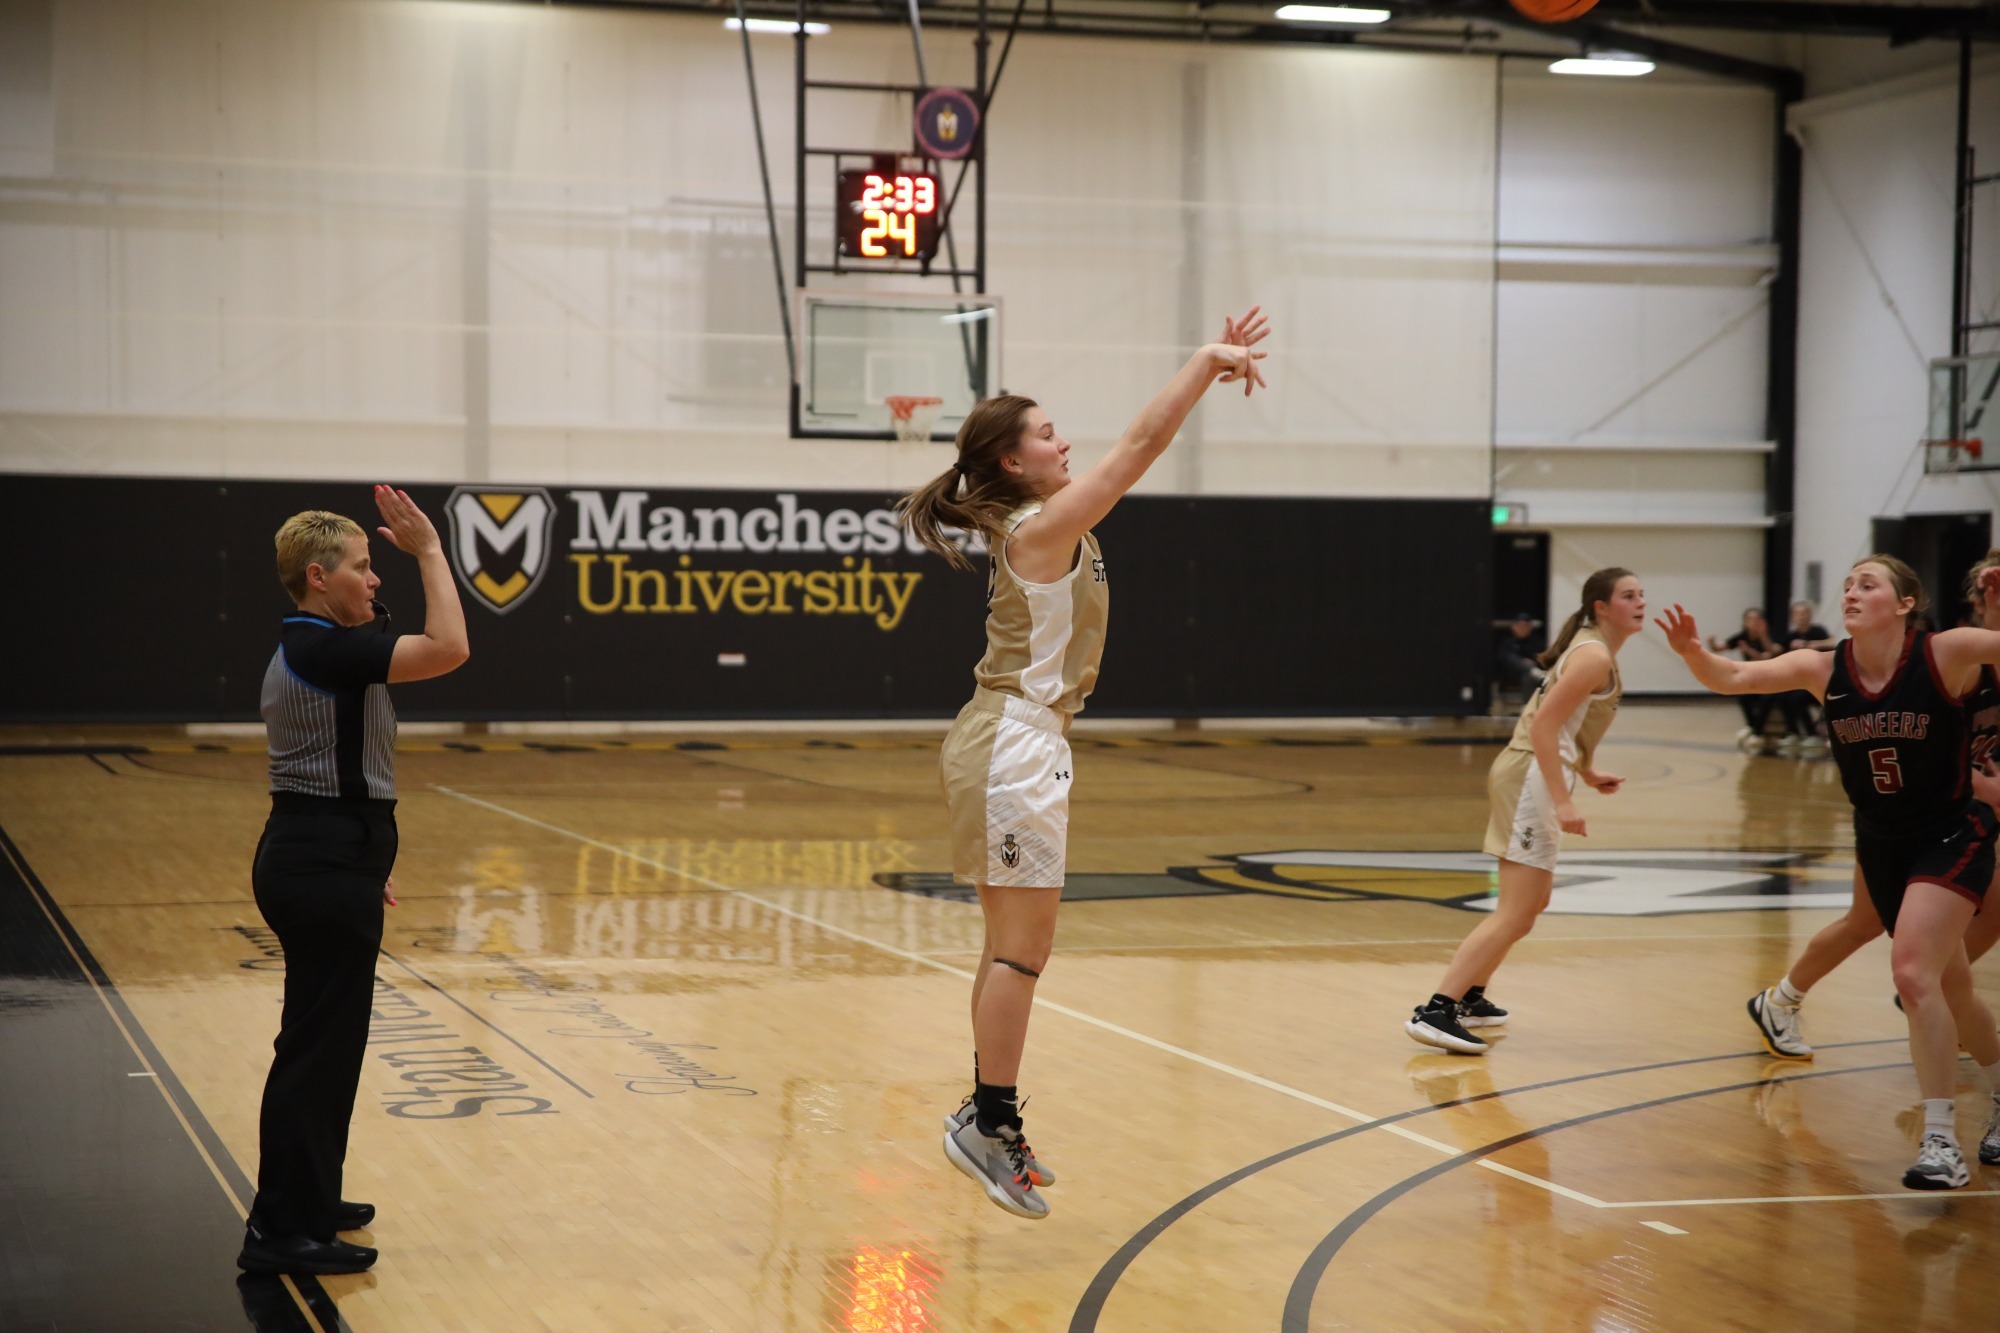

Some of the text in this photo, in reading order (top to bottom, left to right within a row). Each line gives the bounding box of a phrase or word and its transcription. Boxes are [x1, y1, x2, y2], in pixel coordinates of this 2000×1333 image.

[862, 174, 936, 214] 2:33
[860, 208, 916, 257] 24
[568, 554, 922, 631] University
[1868, 747, 1904, 794] 5
[380, 1046, 561, 1120] Stan
